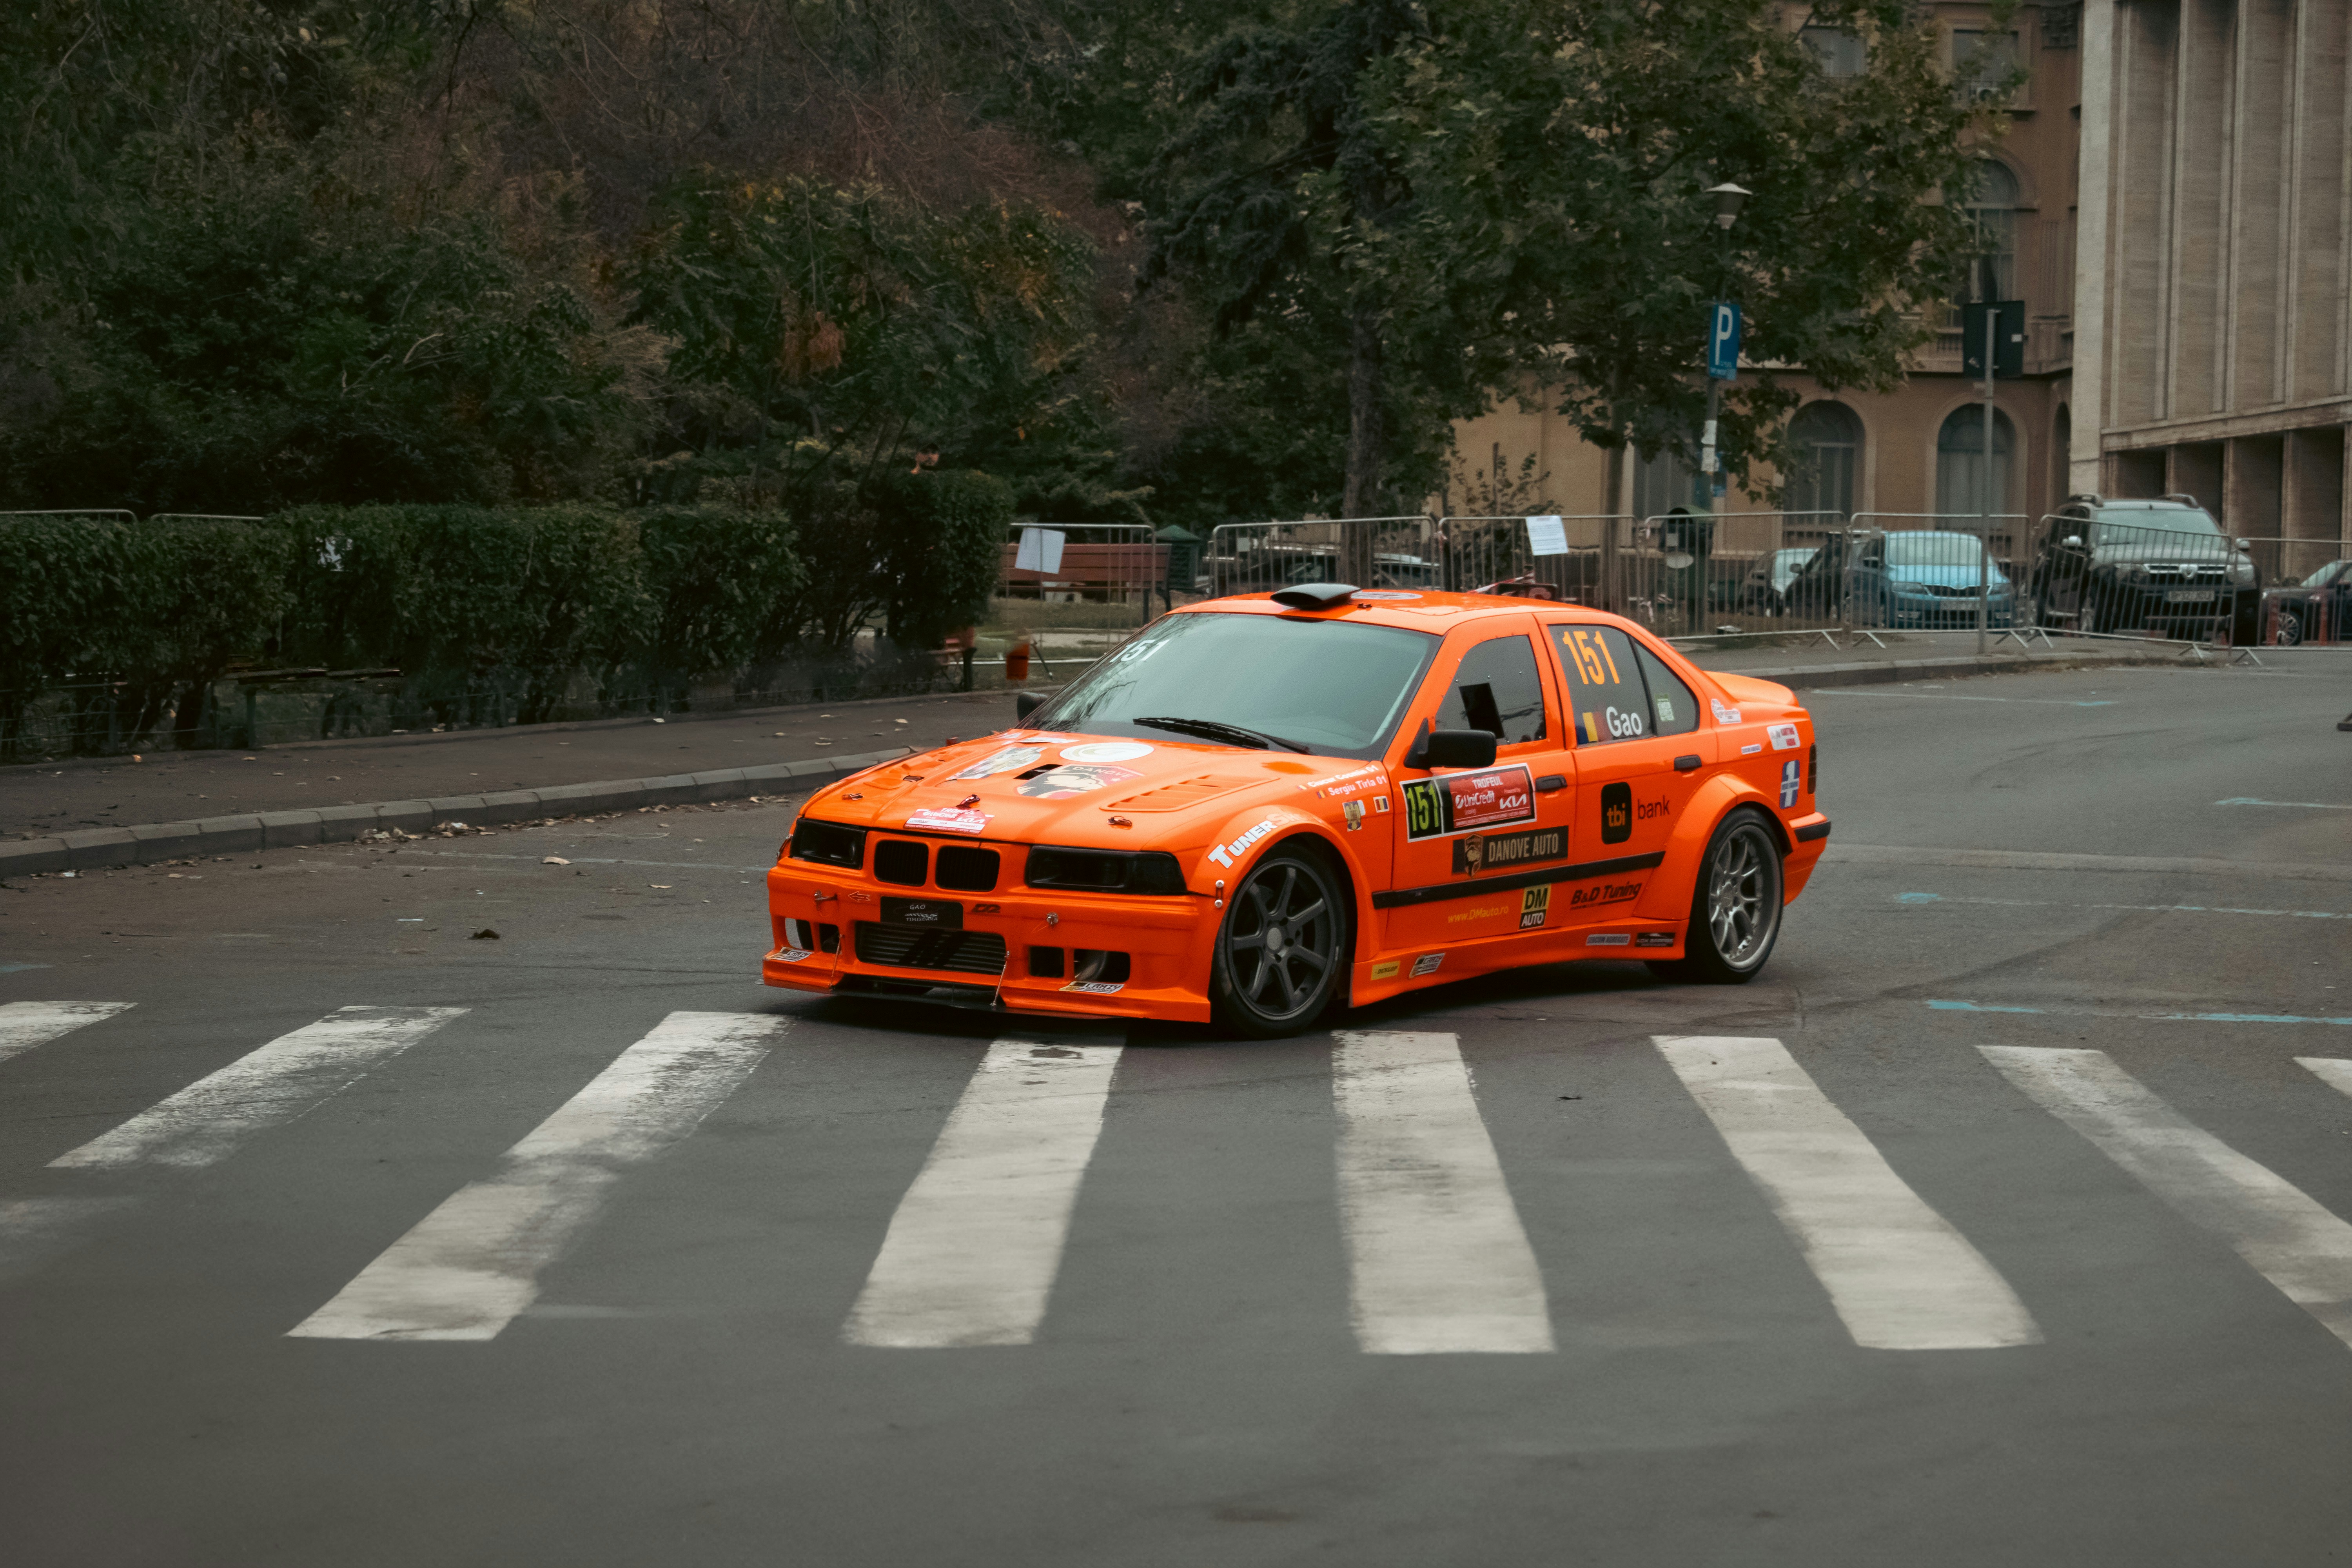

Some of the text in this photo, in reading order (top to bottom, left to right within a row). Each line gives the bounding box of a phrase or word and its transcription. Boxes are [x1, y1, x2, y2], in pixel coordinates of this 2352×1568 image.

[1715, 306, 1733, 365] P
[1109, 639, 1170, 662] 151
[1563, 631, 1620, 684] 151
[1606, 706, 1642, 737] Gao
[1073, 766, 1134, 778] DANOVE
[1335, 770, 1368, 780] Cosmin
[1472, 776, 1503, 789] TROFEUL
[1328, 775, 1387, 795] Sergiu Tirla 01
[1406, 784, 1439, 831] 151
[1463, 790, 1495, 807] UniCredit
[1499, 793, 1526, 809] KIA
[1607, 795, 1670, 827] tbi bank
[1488, 833, 1559, 862] DANOVE AUTO
[1524, 888, 1548, 910] DM
[1570, 881, 1642, 905] B&D Tuning
[1448, 906, 1509, 923] www.DMauto.ro
[1521, 912, 1544, 927] AUTO
[1377, 966, 1398, 974] DUNLOP
